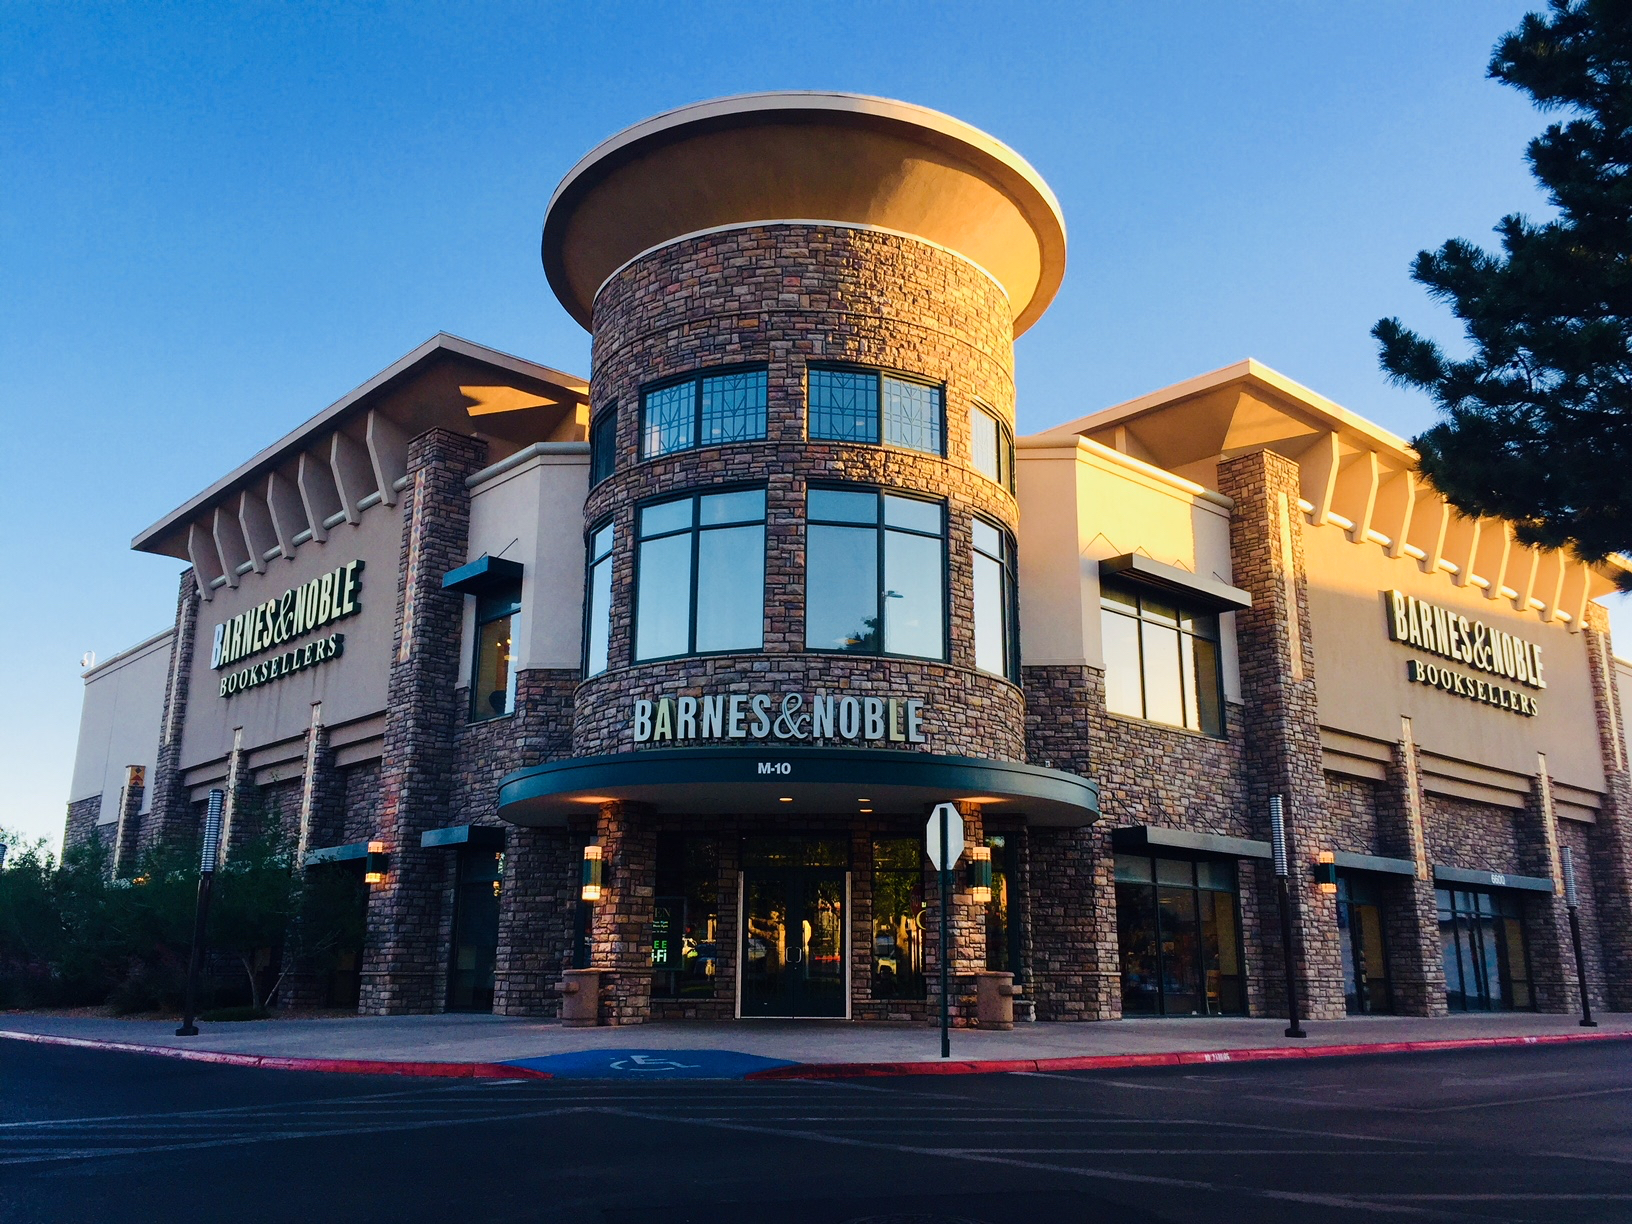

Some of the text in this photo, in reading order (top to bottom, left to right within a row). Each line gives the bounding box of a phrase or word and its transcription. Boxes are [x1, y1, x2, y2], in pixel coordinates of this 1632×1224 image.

[219, 633, 338, 697] BOOKSELLERS
[1414, 659, 1538, 717] BOOKSELLERS
[757, 762, 792, 775] M-10
[1491, 873, 1506, 885] 6600
[653, 940, 668, 949] EE
[651, 949, 667, 963] i-Fi
